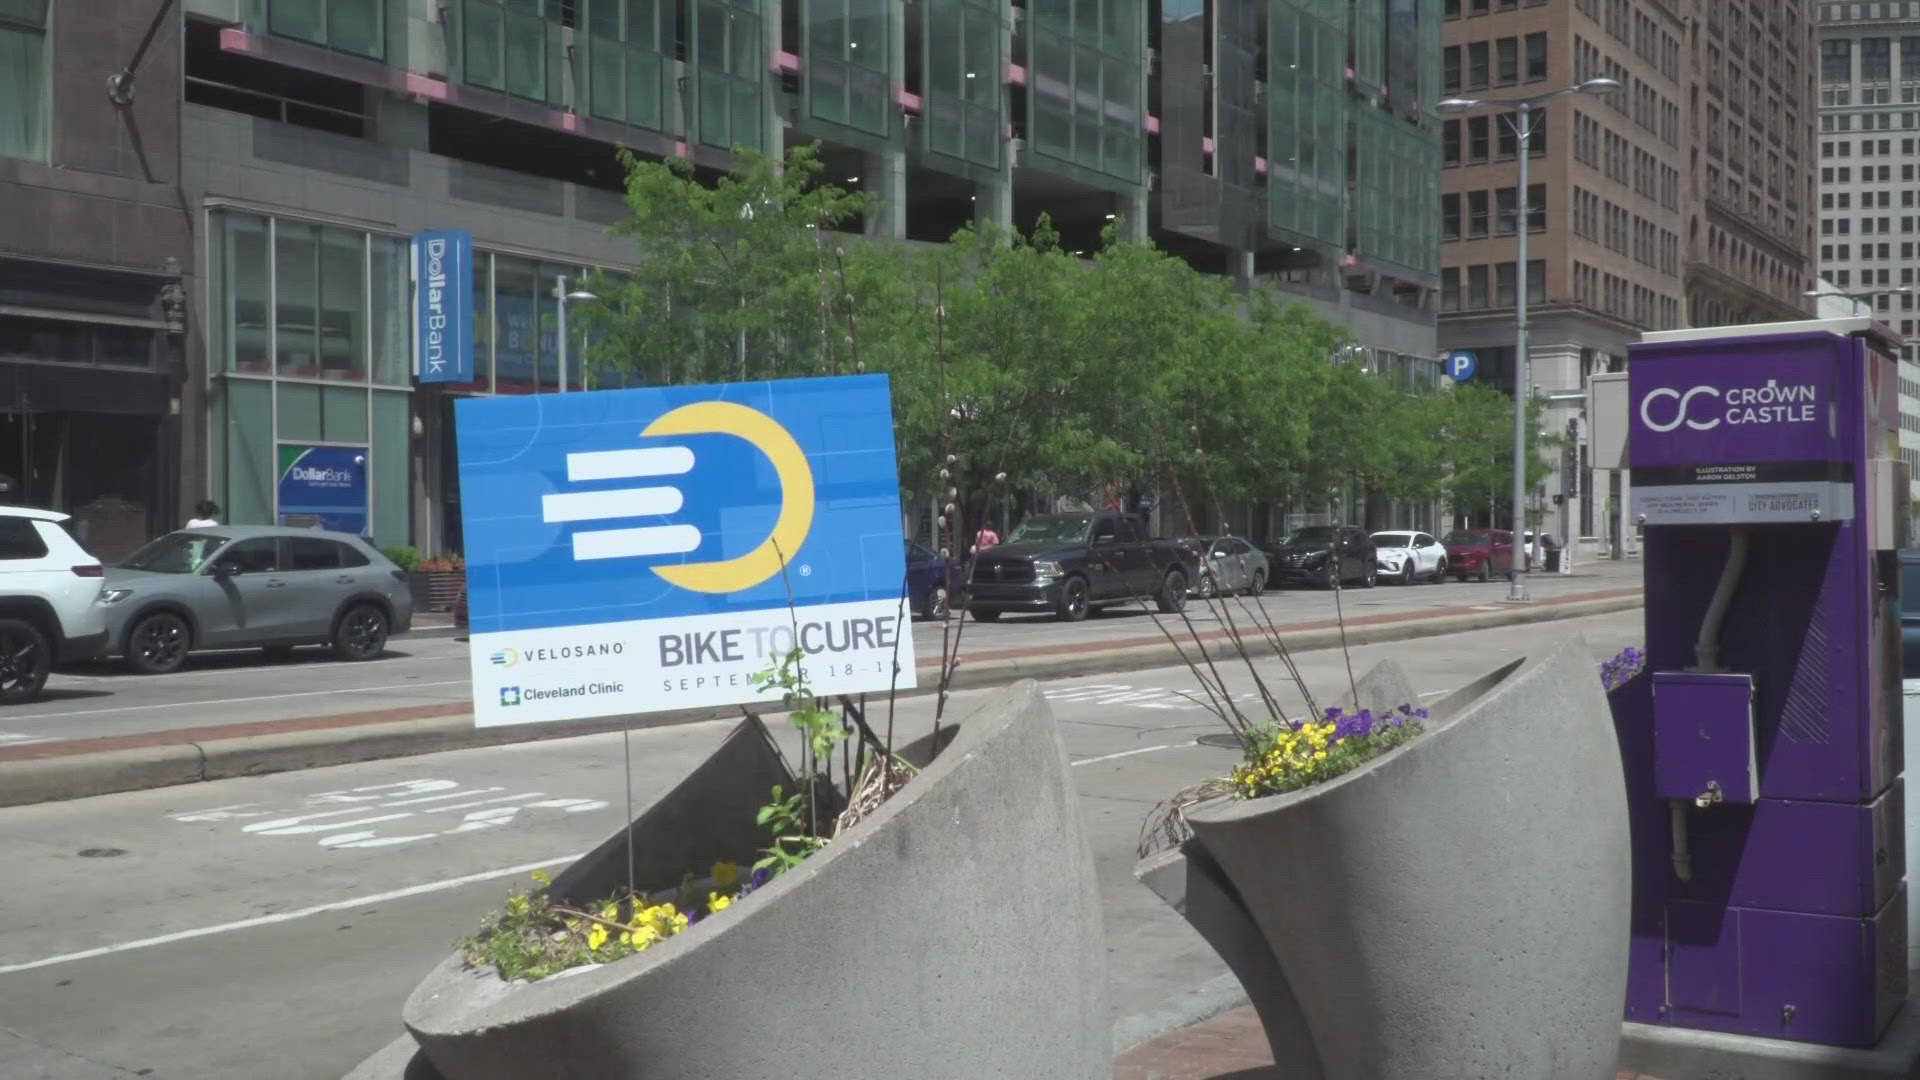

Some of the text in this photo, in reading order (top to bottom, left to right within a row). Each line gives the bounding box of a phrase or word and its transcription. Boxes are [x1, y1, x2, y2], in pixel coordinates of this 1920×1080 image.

[428, 239, 448, 373] DollarBank
[1453, 356, 1470, 376] P
[1725, 383, 1816, 405] CROWN
[1725, 405, 1816, 425] CASTLE
[1746, 465, 1757, 473] BY
[1748, 499, 1820, 512] CITY ADVOCATES
[659, 616, 897, 667] BIKE TO CURE
[524, 642, 624, 662] VELOSANO
[524, 681, 624, 701] Cleveland Clinic
